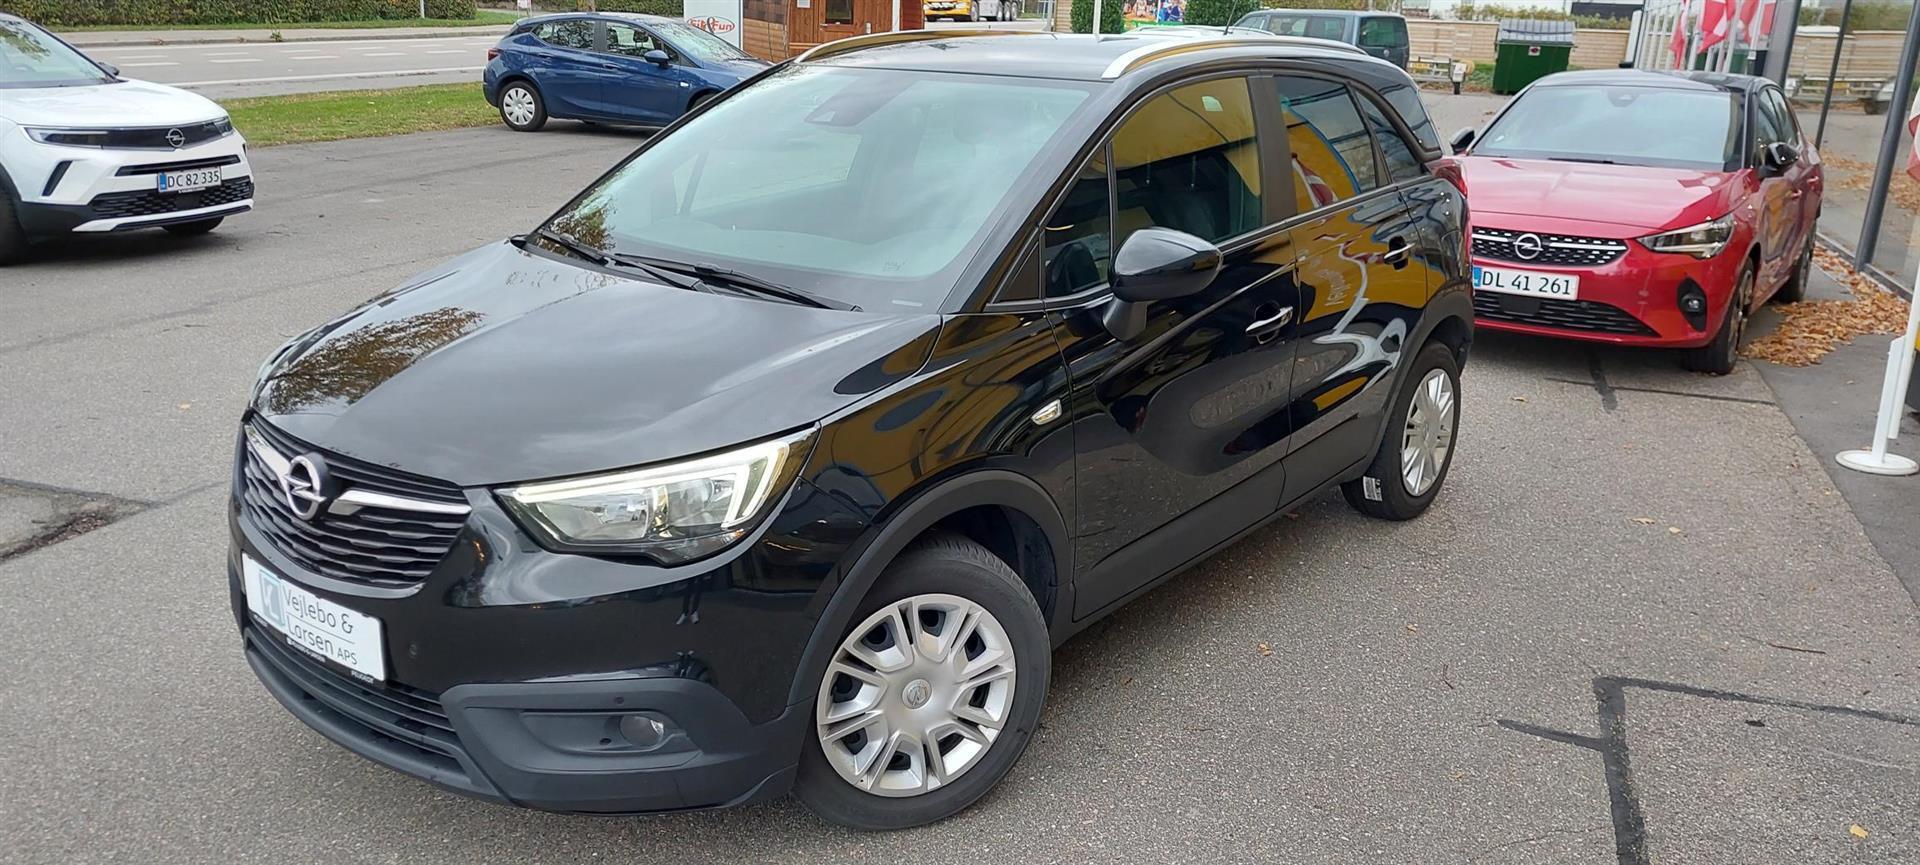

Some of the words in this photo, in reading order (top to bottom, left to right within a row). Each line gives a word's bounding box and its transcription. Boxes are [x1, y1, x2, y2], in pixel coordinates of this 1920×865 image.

[167, 175, 183, 188] DC
[185, 173, 199, 186] 82
[201, 170, 220, 184] 335
[1482, 271, 1505, 288] DL
[1511, 274, 1530, 291] 41
[1538, 277, 1570, 295] 261
[282, 584, 336, 627] Vejlebo
[341, 613, 353, 634] &
[286, 614, 334, 655] Larsen
[337, 648, 358, 665] APS
